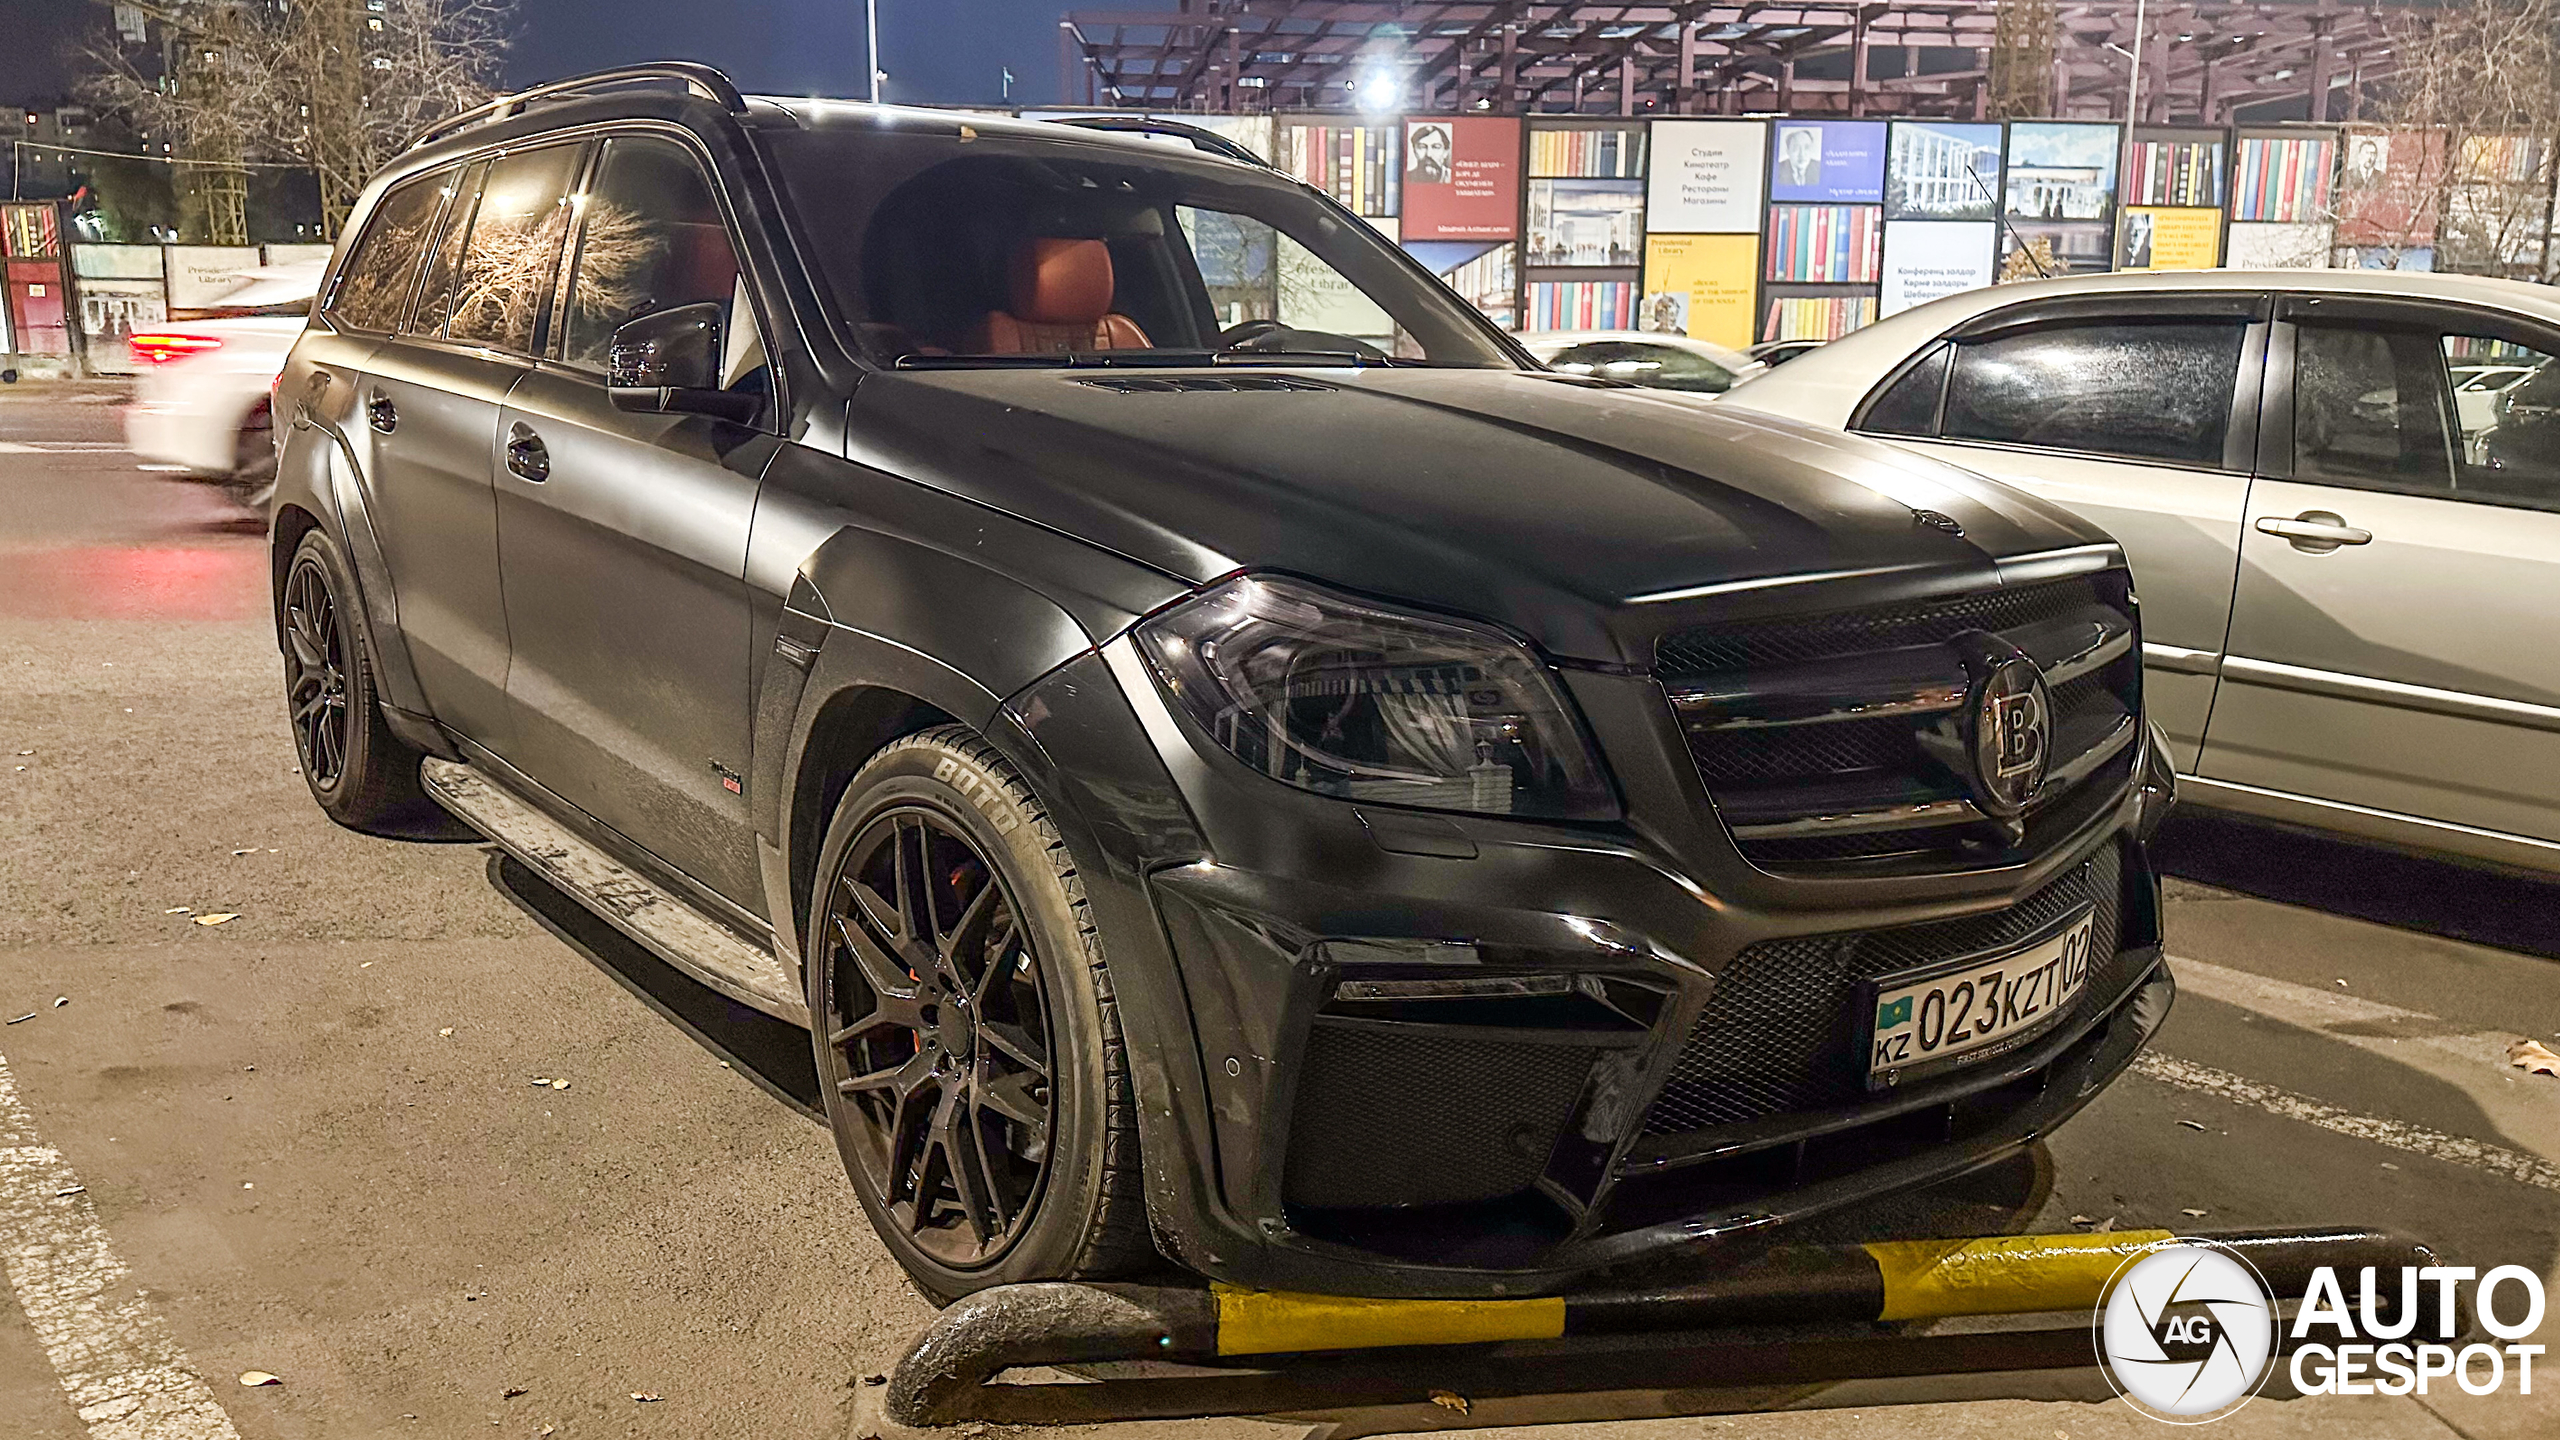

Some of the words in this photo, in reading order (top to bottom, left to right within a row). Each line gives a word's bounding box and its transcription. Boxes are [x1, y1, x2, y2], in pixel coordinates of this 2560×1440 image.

[1691, 147, 1723, 157] Студии
[1683, 160, 1730, 170] Кинотеатр
[1694, 172, 1717, 182] Кафе
[1682, 184, 1729, 193] Рестораны
[1683, 196, 1727, 205] Магазины
[1658, 247, 1684, 255] Library
[1897, 267, 1944, 276] Конференц
[1946, 268, 1976, 276] залдар
[932, 756, 1019, 836] BOTO
[1875, 1032, 1912, 1067] KZ
